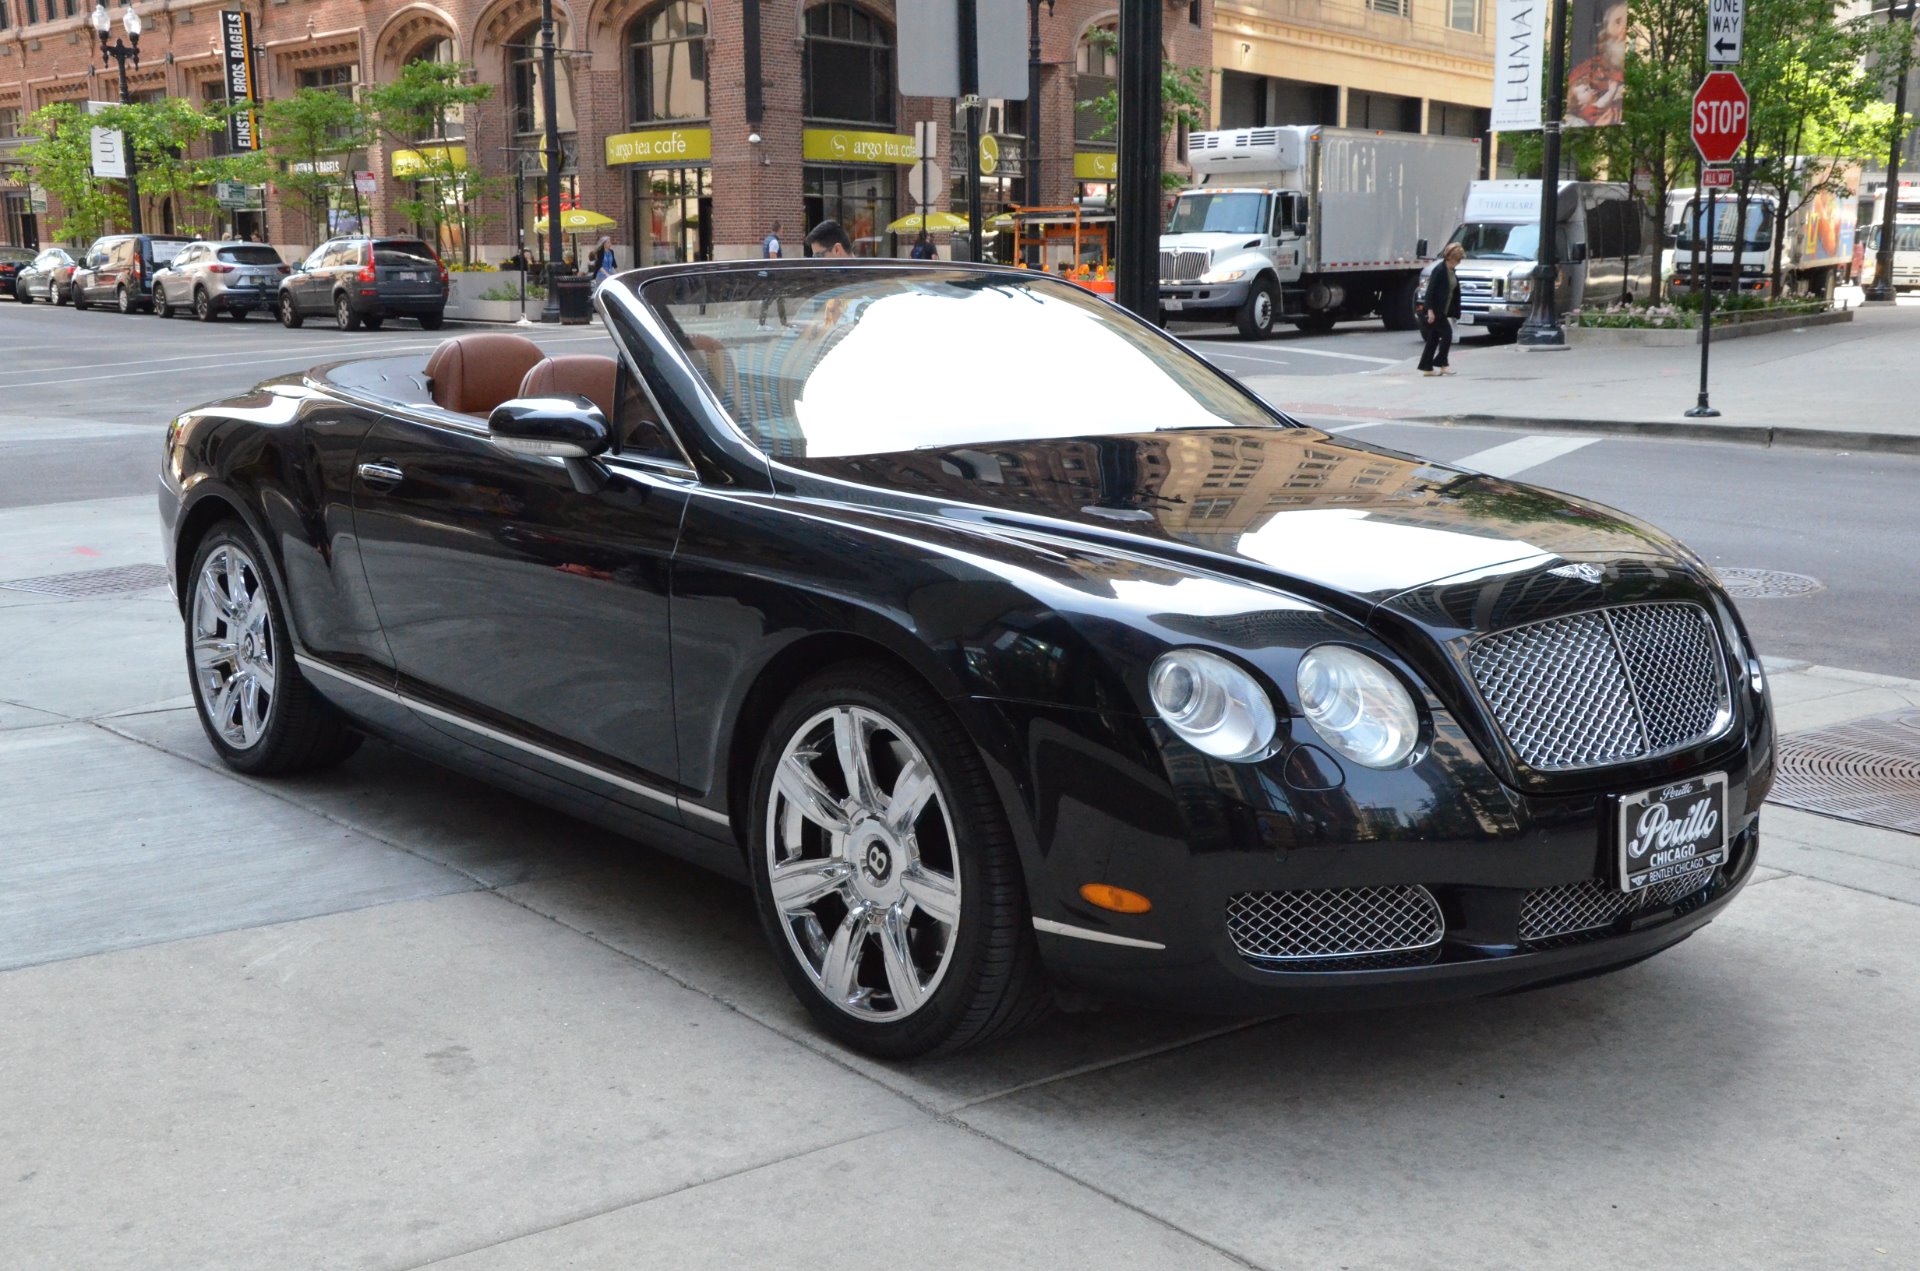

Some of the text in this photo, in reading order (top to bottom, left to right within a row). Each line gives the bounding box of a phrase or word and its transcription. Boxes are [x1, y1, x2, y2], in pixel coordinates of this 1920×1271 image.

[1713, 0, 1739, 12] ONE
[1712, 16, 1739, 33] WAY
[1506, 7, 1533, 103] LUMA
[228, 14, 251, 147] EINSTN BROS. BAGELS
[1696, 100, 1745, 134] STOP
[616, 131, 686, 160] argo tea café
[853, 142, 882, 160] argo
[885, 140, 898, 156] tea
[319, 161, 340, 173] BAGELS
[1705, 173, 1730, 184] ALL WAY
[1485, 200, 1535, 209] THE CLARE
[1660, 783, 1694, 801] Perillo
[1628, 797, 1718, 858] Perillo
[868, 846, 887, 876] B
[1650, 843, 1696, 867] CHICAGO
[1649, 857, 1704, 882] BENTLEY CHICAGO
